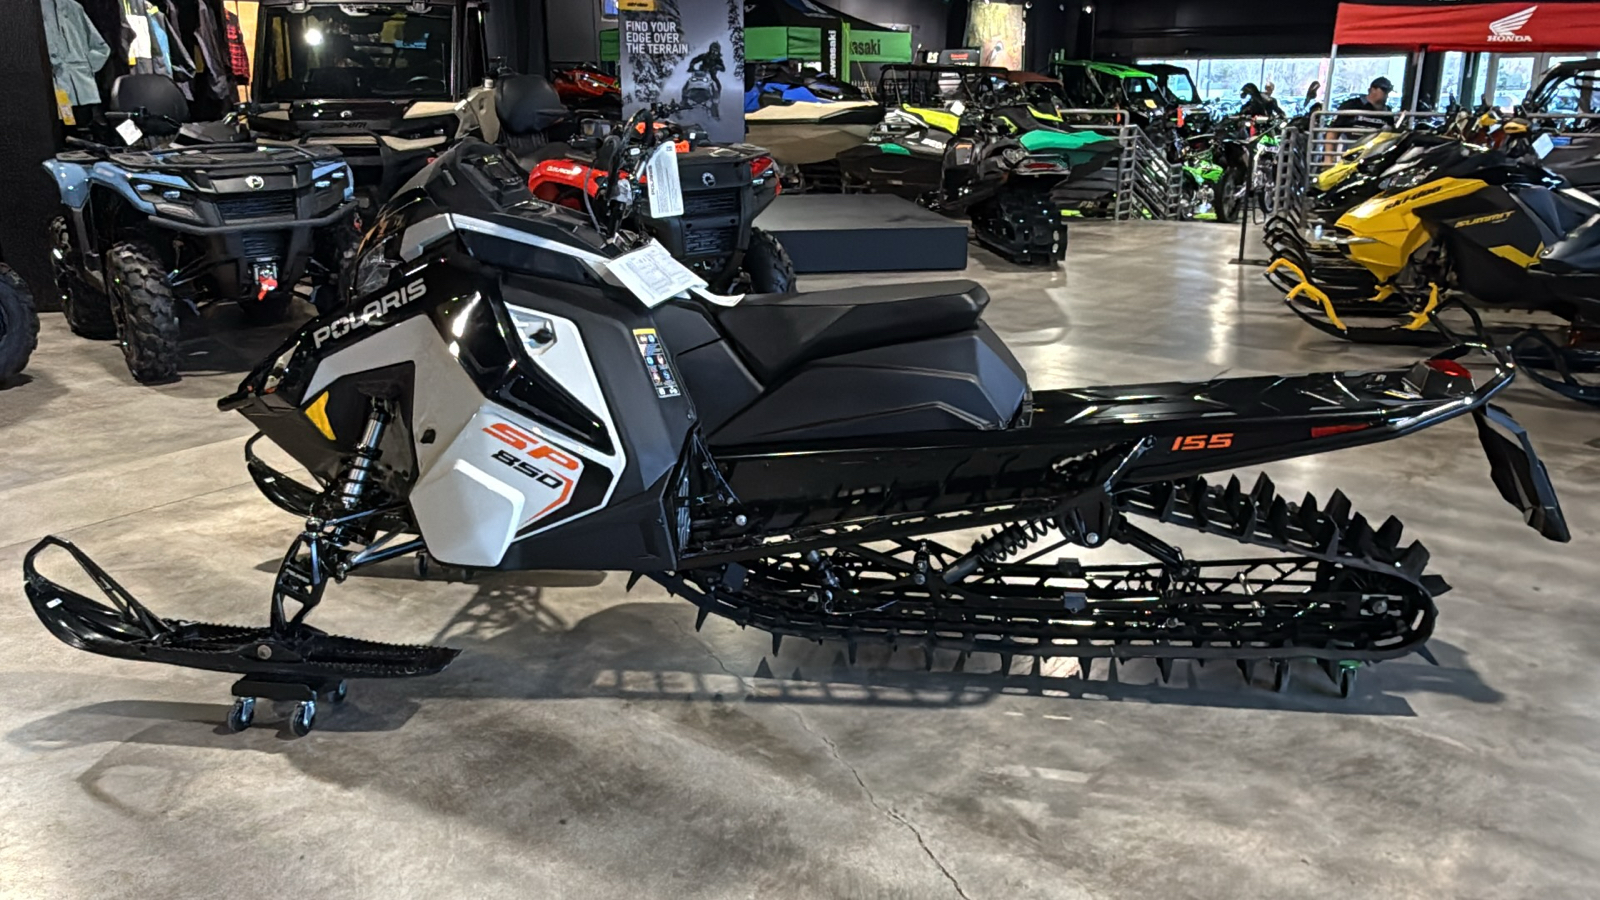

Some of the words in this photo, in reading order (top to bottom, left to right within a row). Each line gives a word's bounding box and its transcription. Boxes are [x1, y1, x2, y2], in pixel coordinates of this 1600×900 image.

[625, 21, 649, 32] FIND
[651, 22, 677, 32] YOUR
[626, 32, 651, 43] EDGE
[653, 33, 679, 43] OVER
[1487, 34, 1533, 42] HONDA
[626, 43, 645, 54] THE
[648, 43, 688, 54] TERRAIN
[1454, 210, 1516, 228] SUMMIT
[313, 278, 427, 349] POLARIS
[481, 423, 579, 471] SP
[1171, 433, 1234, 451] 155
[491, 449, 563, 489] 850
